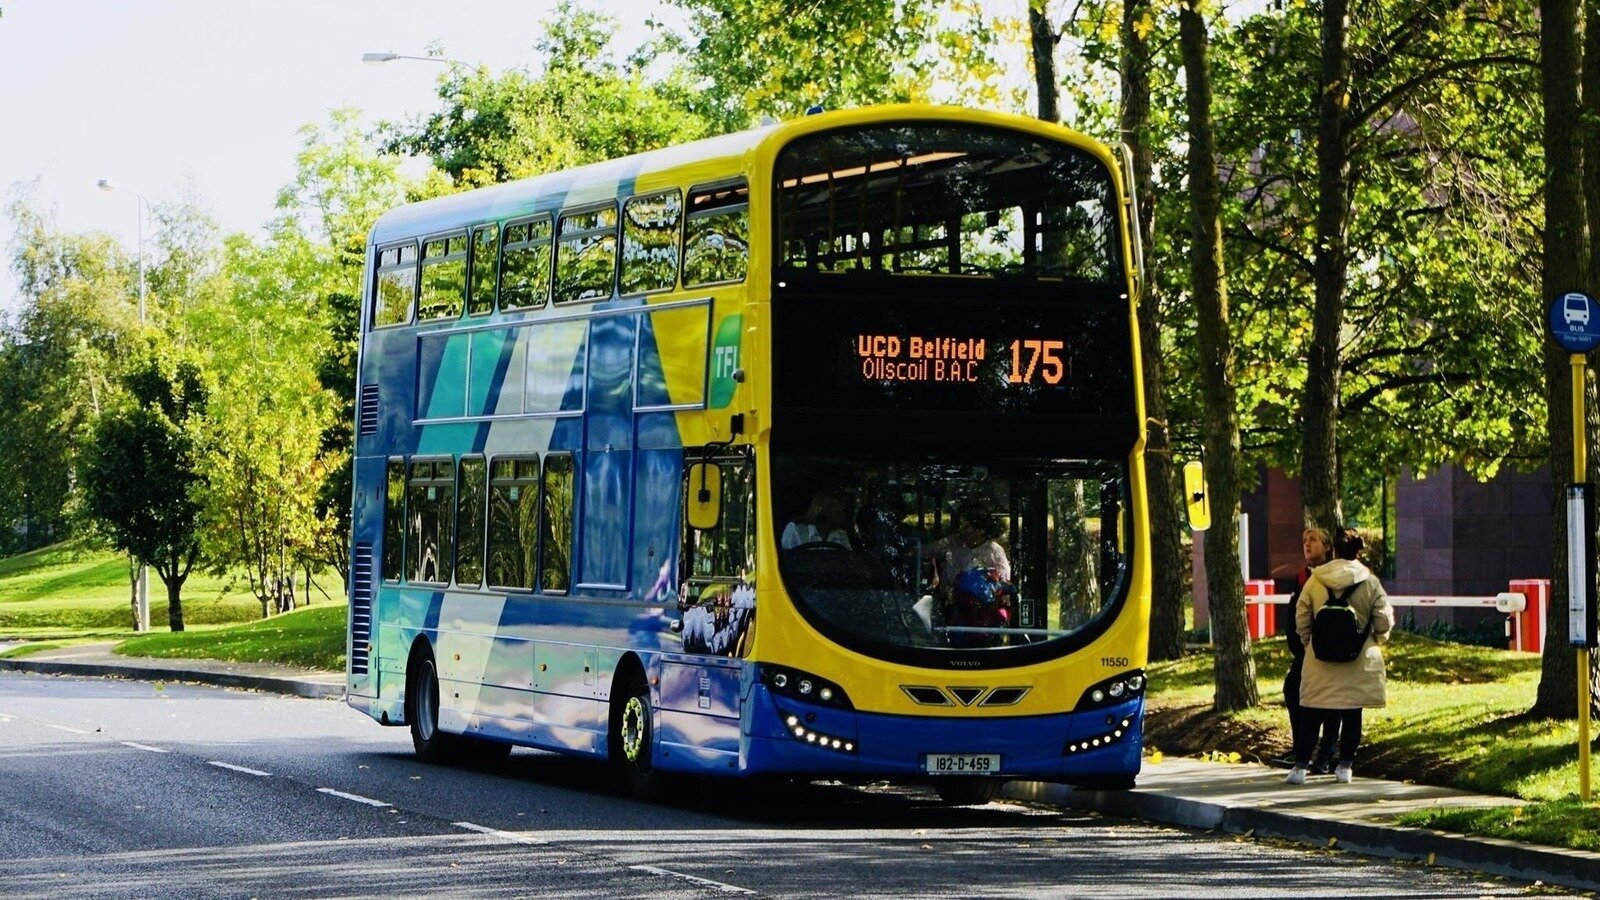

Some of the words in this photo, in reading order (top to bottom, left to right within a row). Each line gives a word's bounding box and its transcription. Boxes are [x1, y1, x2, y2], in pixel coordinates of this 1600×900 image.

[1569, 324, 1585, 332] BUS
[858, 334, 900, 357] UCD
[909, 336, 986, 360] Belfield
[863, 357, 928, 381] Ollscoil
[934, 360, 979, 382] B.A.C
[1009, 339, 1064, 384] 175
[1101, 656, 1129, 668] 11550
[936, 757, 990, 771] 182-D-459
